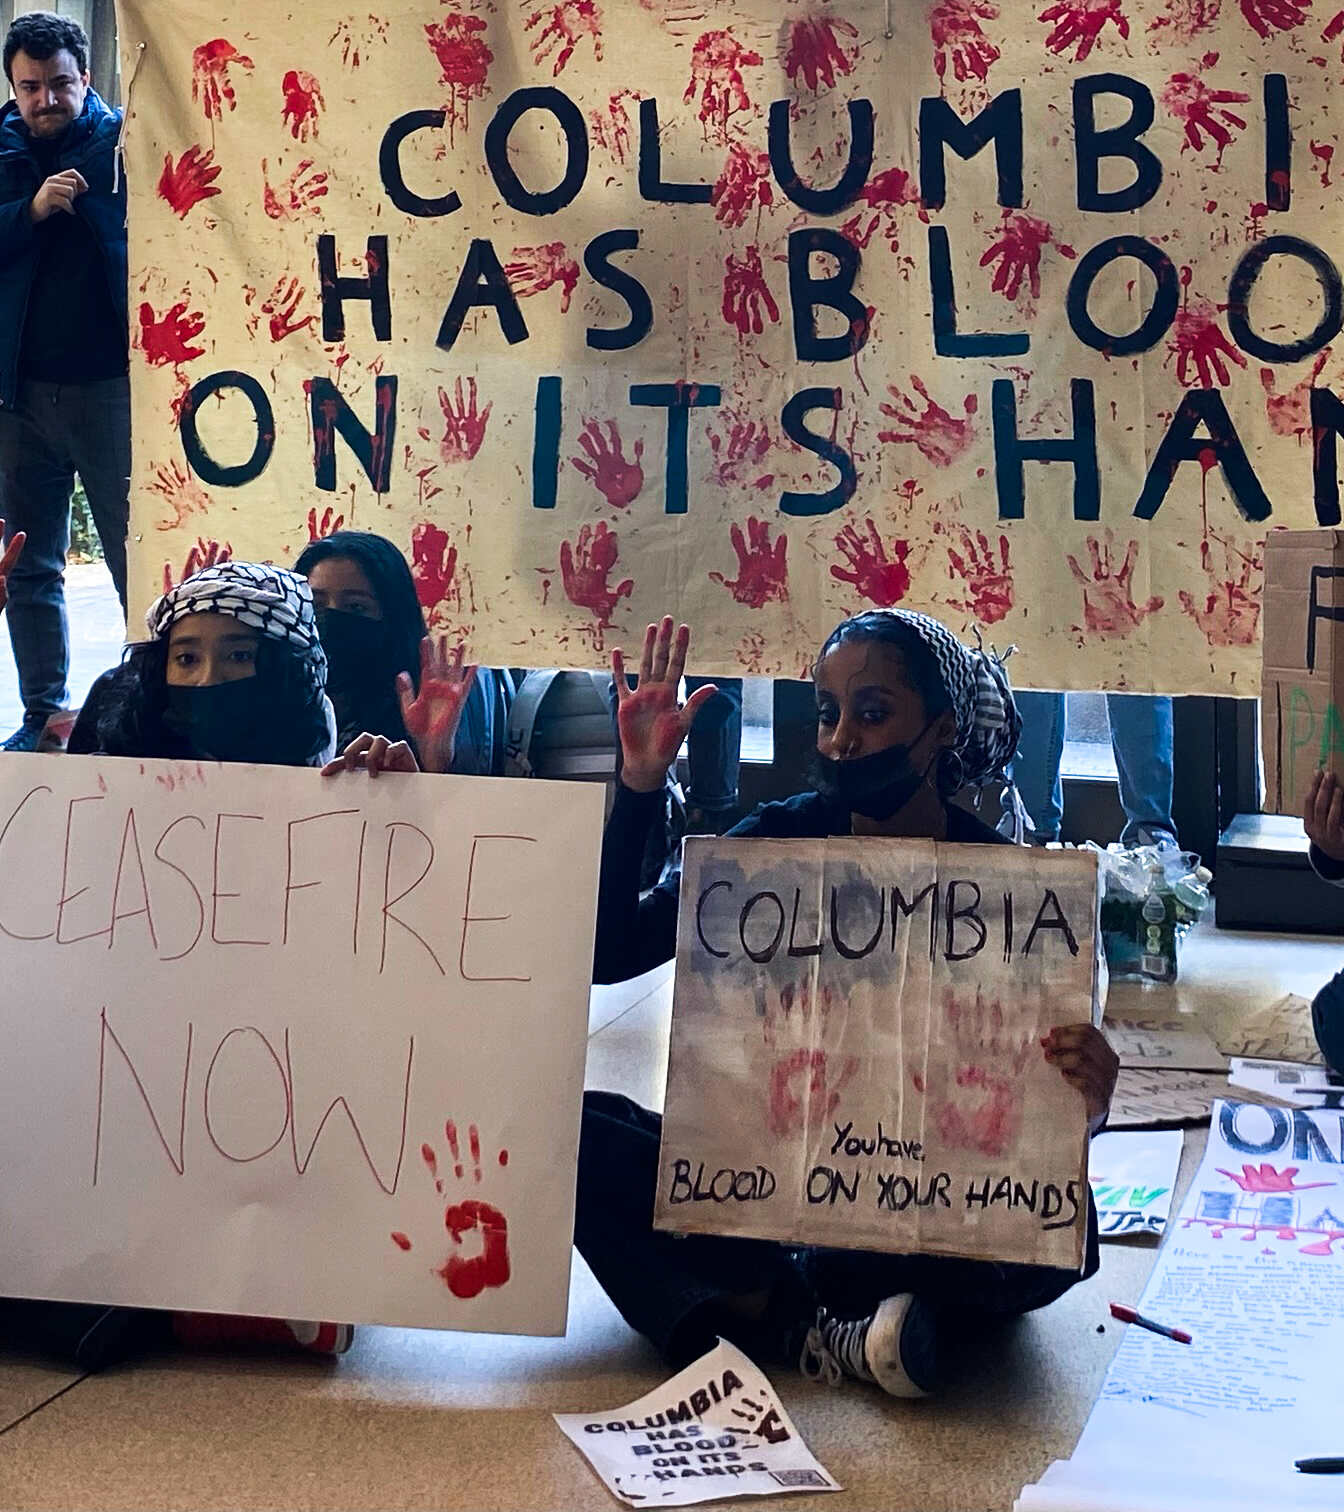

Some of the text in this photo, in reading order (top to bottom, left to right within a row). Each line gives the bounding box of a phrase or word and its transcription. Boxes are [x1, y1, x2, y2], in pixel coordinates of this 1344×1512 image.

[317, 228, 654, 352] HAS
[181, 370, 398, 493] ON
[532, 375, 858, 517] ITS
[696, 878, 1080, 965] COLUMBIA
[92, 1005, 415, 1196] NOW
[668, 1158, 776, 1205] BLOOD
[806, 1165, 861, 1205] ON
[876, 1170, 952, 1212] YOUR
[965, 1174, 1081, 1231] HANDS
[584, 1368, 744, 1434] COLUMBIA
[646, 1424, 702, 1441] HAS
[632, 1434, 736, 1456] BLOOD
[652, 1451, 742, 1468] ON ITS
[653, 1461, 769, 1482] HANDS
